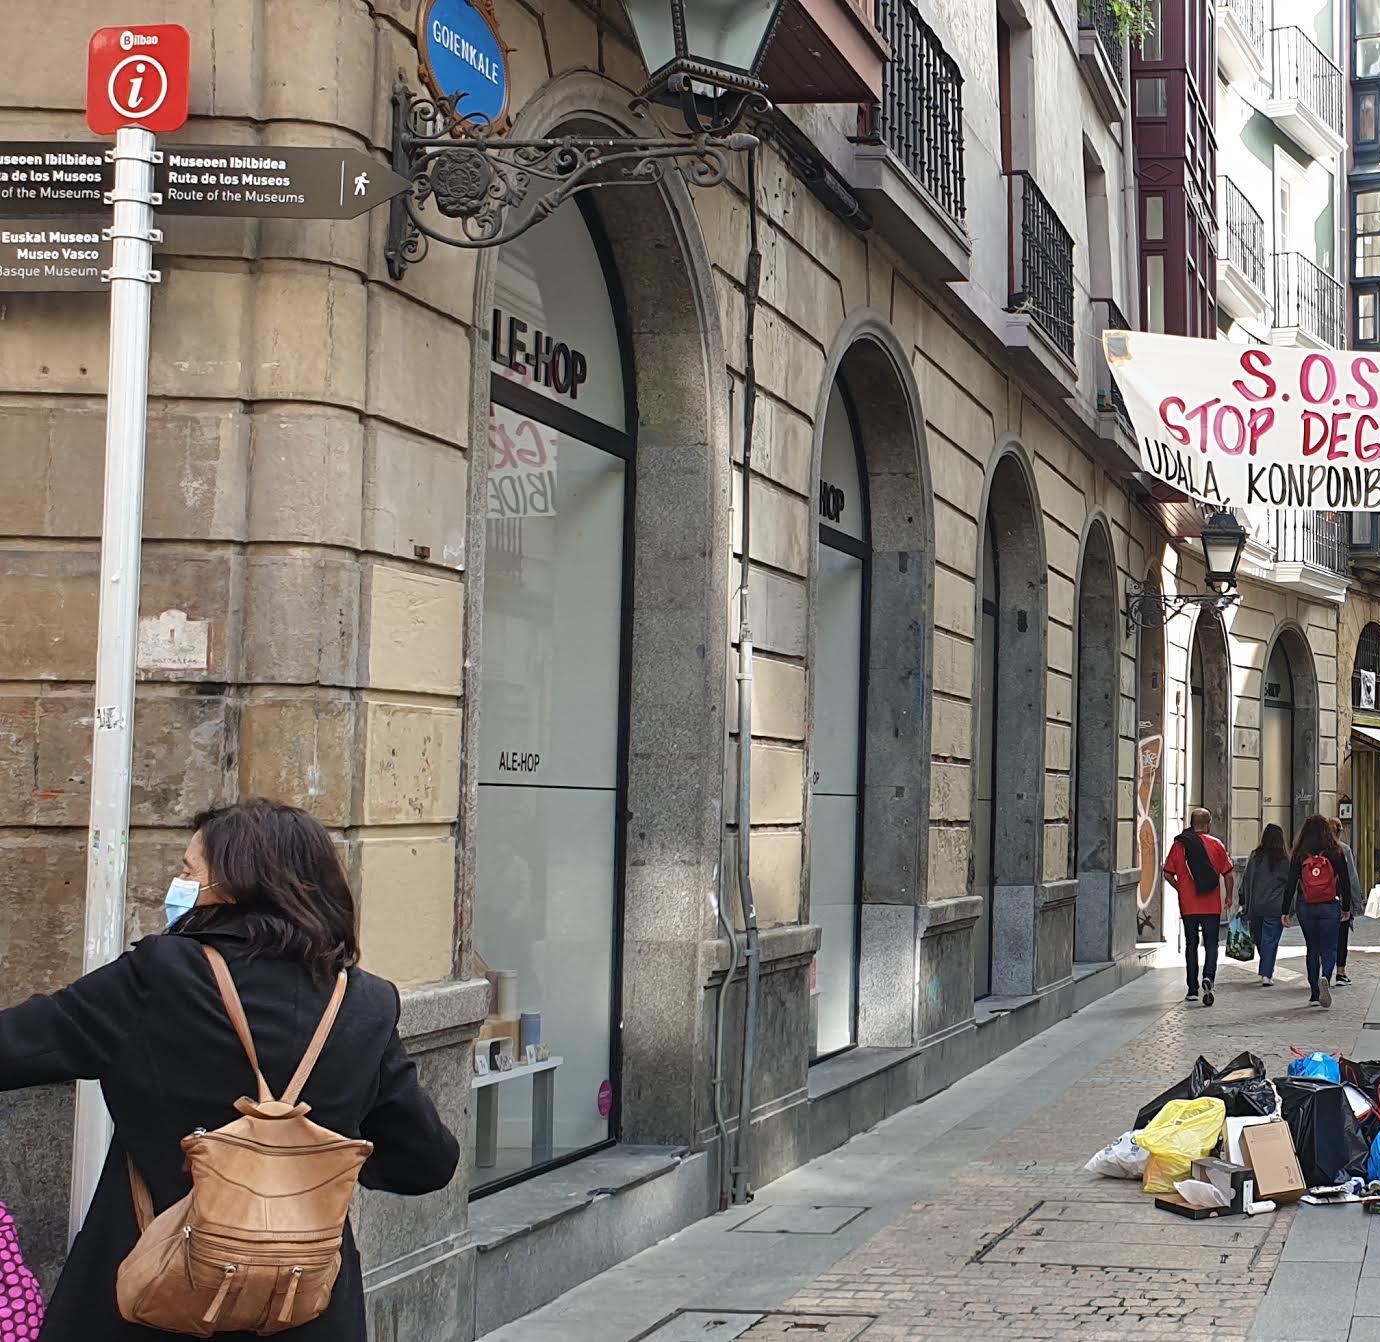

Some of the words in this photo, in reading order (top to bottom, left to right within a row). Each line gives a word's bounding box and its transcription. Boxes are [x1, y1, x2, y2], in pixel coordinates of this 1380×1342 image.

[122, 33, 158, 47] Bilbao
[433, 20, 499, 85] GOIENKALE
[45, 153, 102, 165] Ibilbidea
[169, 155, 227, 168] Museoen
[229, 157, 286, 169] Ibilbidea
[11, 170, 27, 181] de
[30, 170, 50, 181] los
[52, 170, 102, 182] Museos
[168, 172, 198, 183] Ruta
[201, 173, 217, 184] de
[219, 174, 239, 184] los
[242, 174, 290, 186] Museos
[1, 186, 14, 198] of
[17, 187, 37, 198] the
[40, 187, 101, 199] Museums
[168, 188, 203, 200] Route
[206, 189, 219, 201] of
[222, 190, 241, 201] the
[245, 190, 305, 203] Museums
[1, 231, 47, 243] Euskal
[49, 231, 99, 243] Museoa
[17, 248, 59, 260] Museo
[61, 248, 99, 260] Vasco
[44, 265, 98, 276] Museum
[492, 308, 588, 400] LE-HOP
[1159, 396, 1275, 457] STOP
[1144, 436, 1231, 506] UDALA,
[499, 751, 540, 772] ALE-HOP
